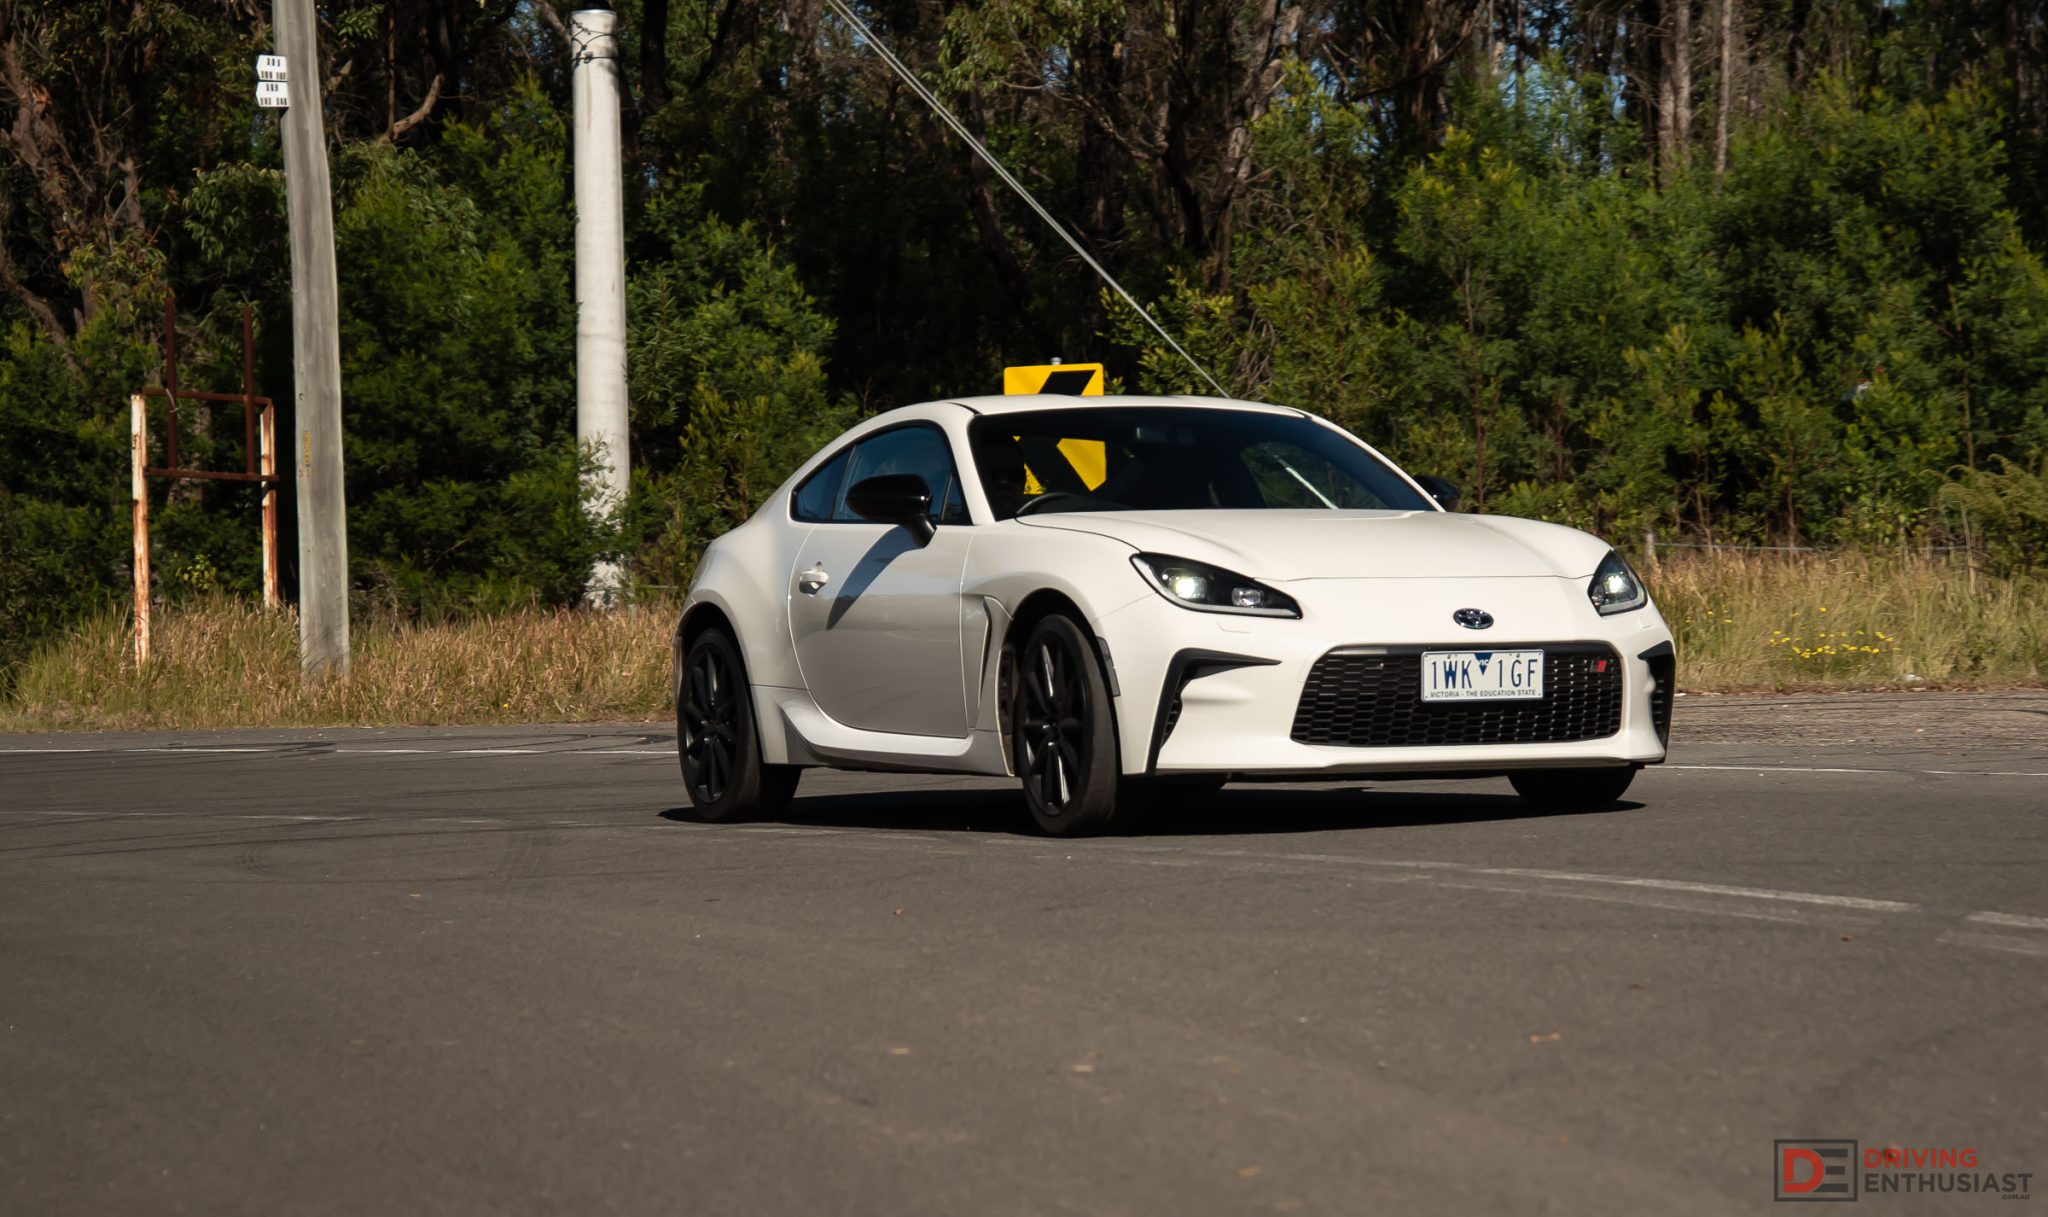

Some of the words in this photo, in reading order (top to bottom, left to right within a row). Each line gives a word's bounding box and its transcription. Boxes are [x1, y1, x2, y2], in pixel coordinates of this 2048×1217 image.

[1431, 660, 1472, 689] 1WK
[1498, 659, 1538, 687] 1GF
[1430, 690, 1460, 698] VICTORIA
[1479, 689, 1516, 697] EDUCATION
[1517, 688, 1536, 696] STATE
